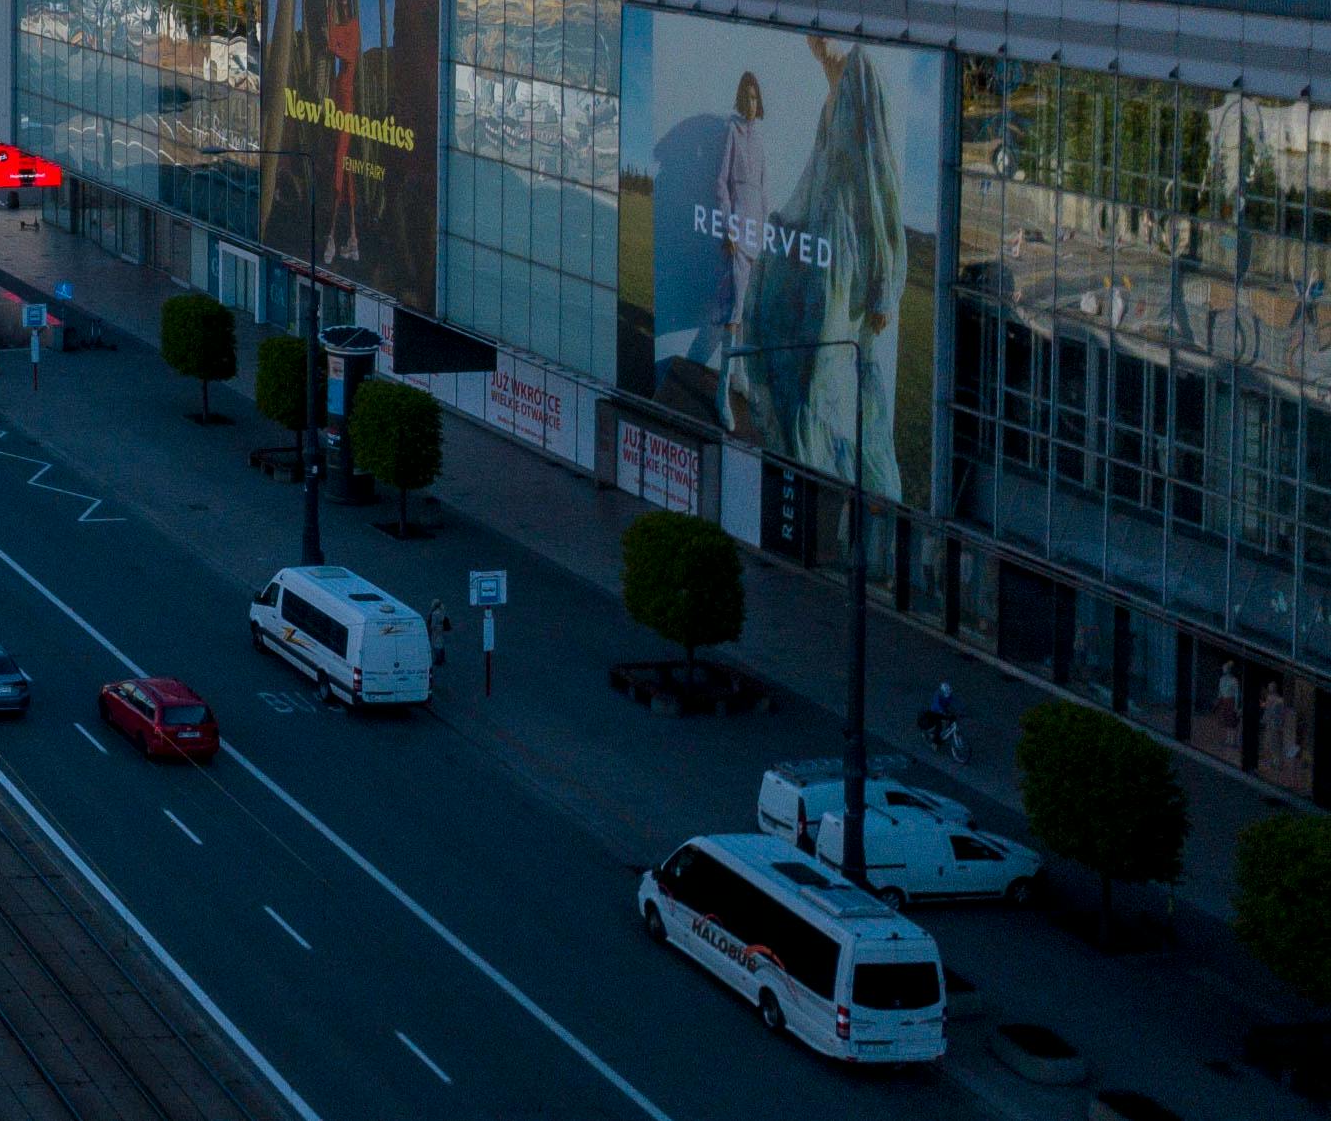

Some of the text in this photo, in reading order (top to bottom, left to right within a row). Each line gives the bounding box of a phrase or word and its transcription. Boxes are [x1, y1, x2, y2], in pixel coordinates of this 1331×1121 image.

[284, 87, 415, 151] New Romantics
[342, 156, 386, 181] JENNY FAIRY
[694, 204, 832, 268] RESERVED
[491, 370, 510, 392] JUŻ
[491, 390, 521, 414] WIELKIE
